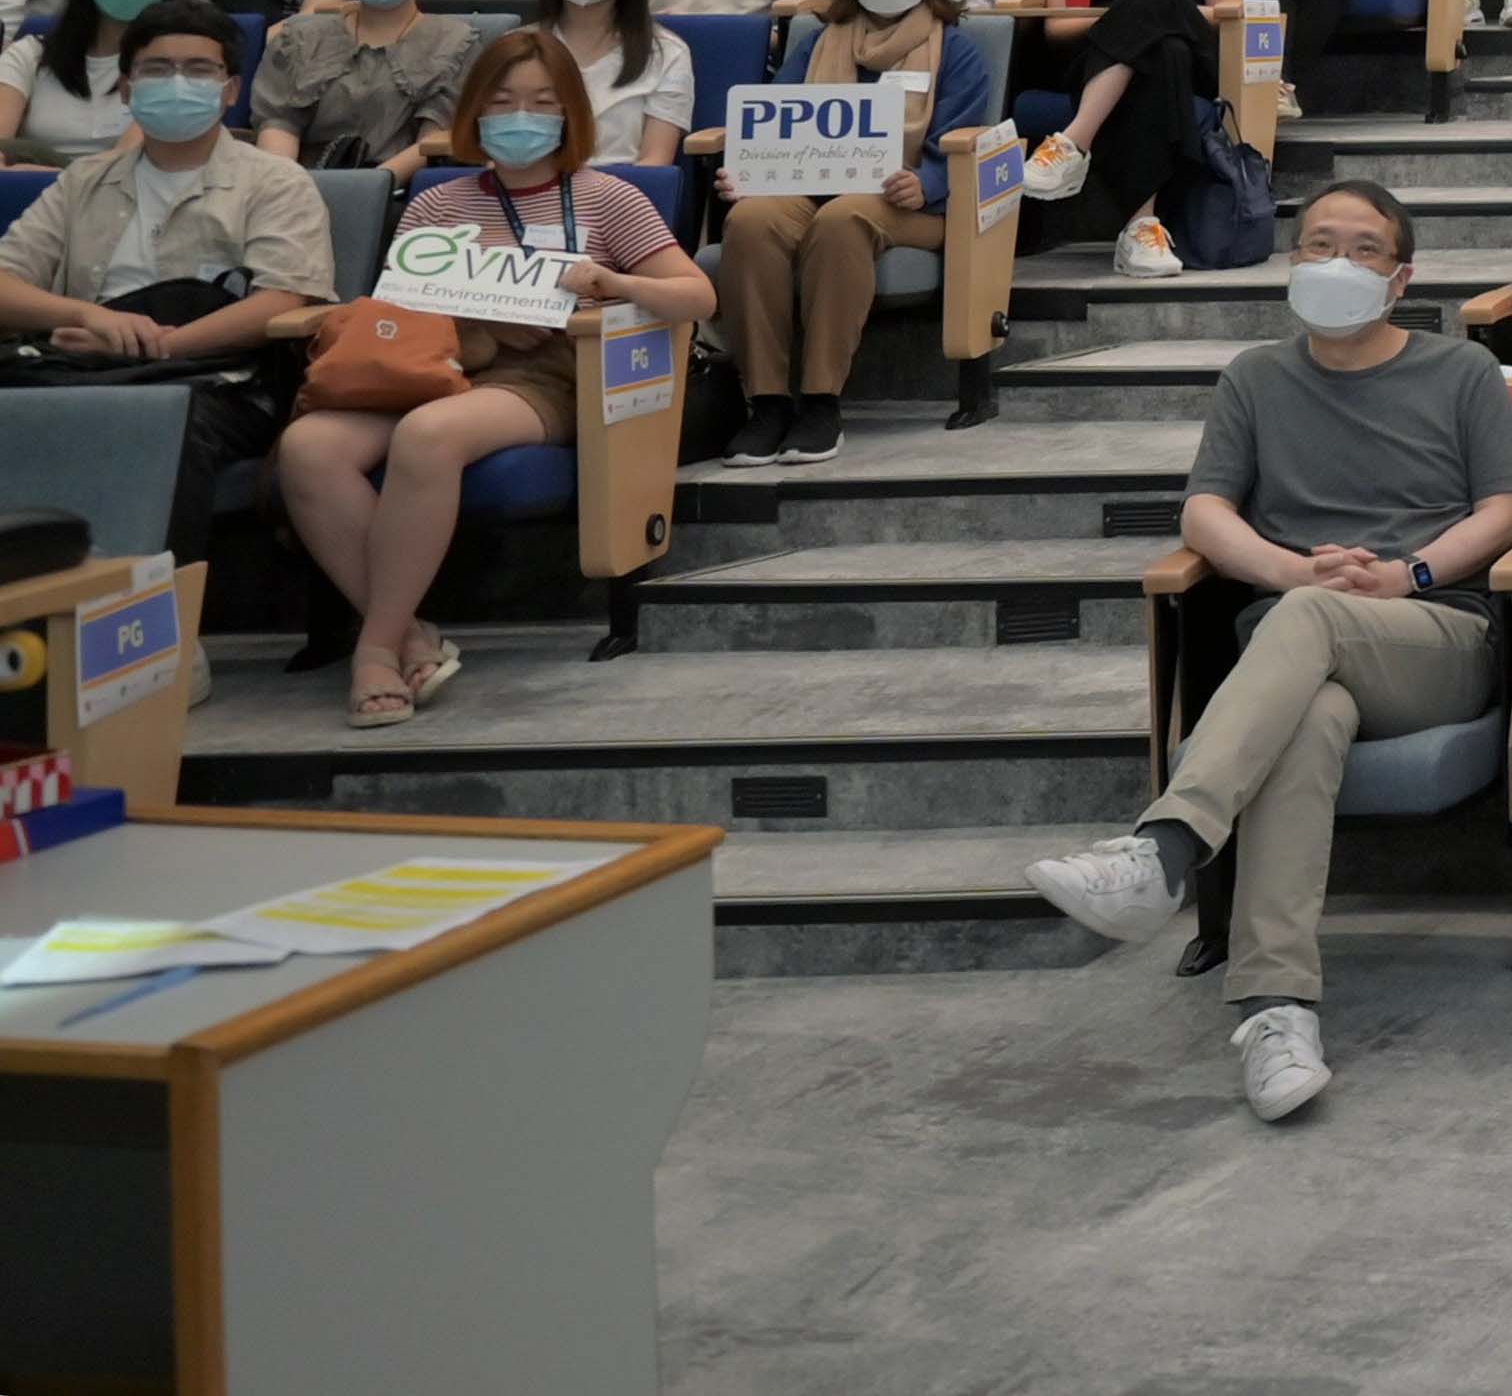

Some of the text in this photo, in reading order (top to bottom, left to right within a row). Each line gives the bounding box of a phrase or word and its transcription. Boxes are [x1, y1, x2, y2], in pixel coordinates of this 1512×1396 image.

[741, 98, 888, 141] PPOL
[738, 144, 889, 166] Division of Public Policy
[994, 162, 1009, 187] PG
[421, 283, 569, 312] Environmental
[631, 347, 649, 372] PG
[117, 619, 145, 655] PG
